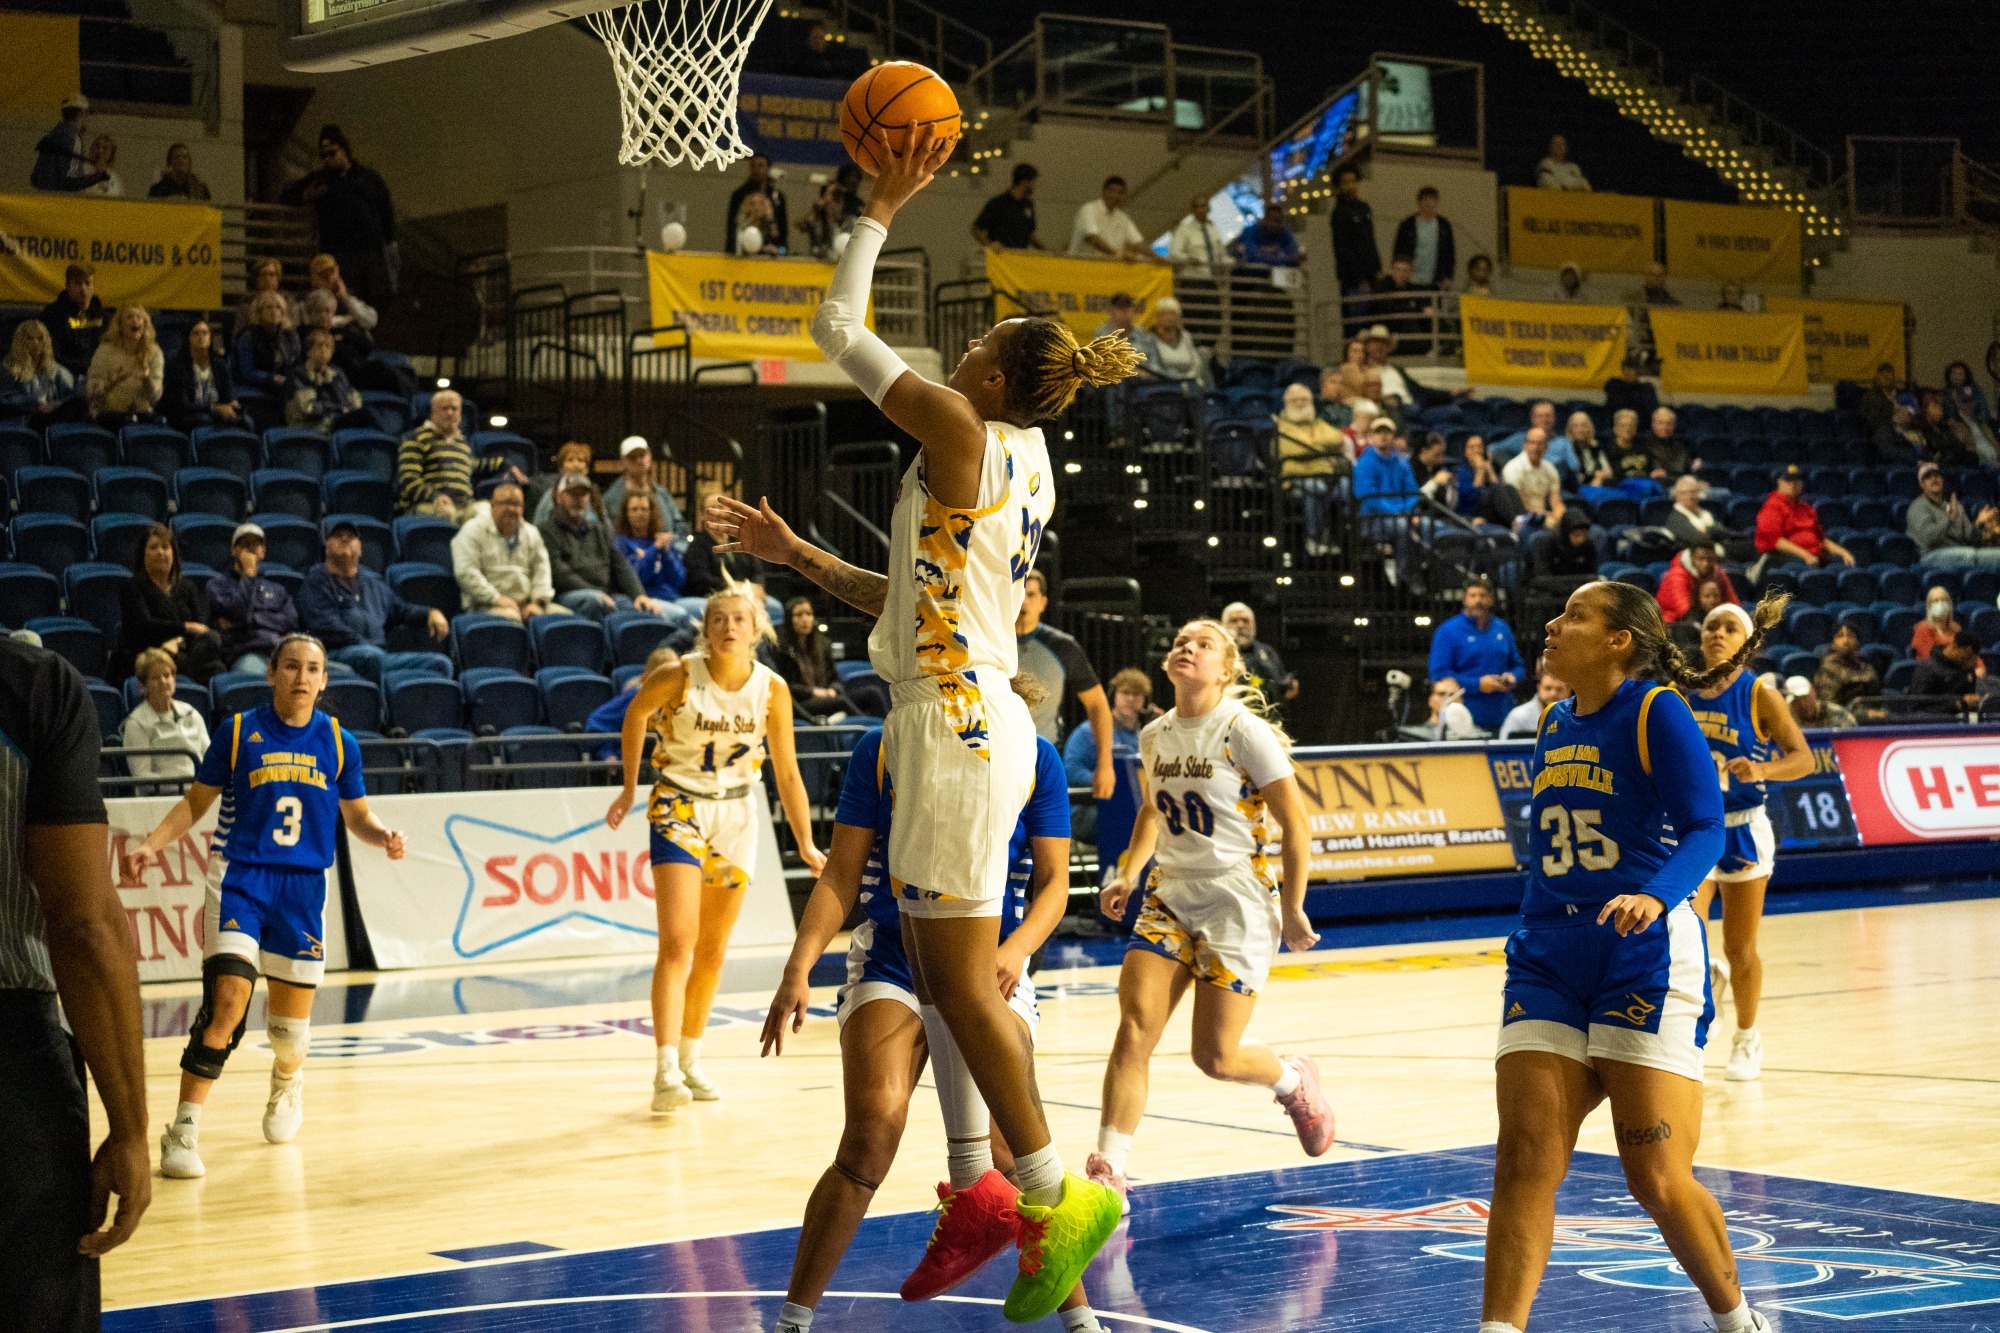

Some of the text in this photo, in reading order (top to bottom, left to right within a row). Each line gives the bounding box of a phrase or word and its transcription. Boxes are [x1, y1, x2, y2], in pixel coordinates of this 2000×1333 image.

[0, 234, 86, 262] TRONG,
[91, 240, 164, 265] BACKUS
[171, 245, 182, 266] &
[700, 279, 829, 305] 1ST COMMUNITY
[746, 315, 802, 337] CREDIT
[694, 713, 730, 736] Angelo
[1183, 756, 1213, 779] State
[1494, 759, 1533, 789] BEL
[273, 796, 303, 847] 3
[1309, 808, 1446, 833] IEW RANCH
[1797, 791, 1841, 830] 18
[1327, 837, 1363, 850] and
[1368, 830, 1446, 847] Hunting
[1449, 828, 1506, 843] Ranch
[1540, 804, 1620, 877] 35
[482, 849, 656, 908] SONIC
[1617, 1118, 1672, 1146] lessed
